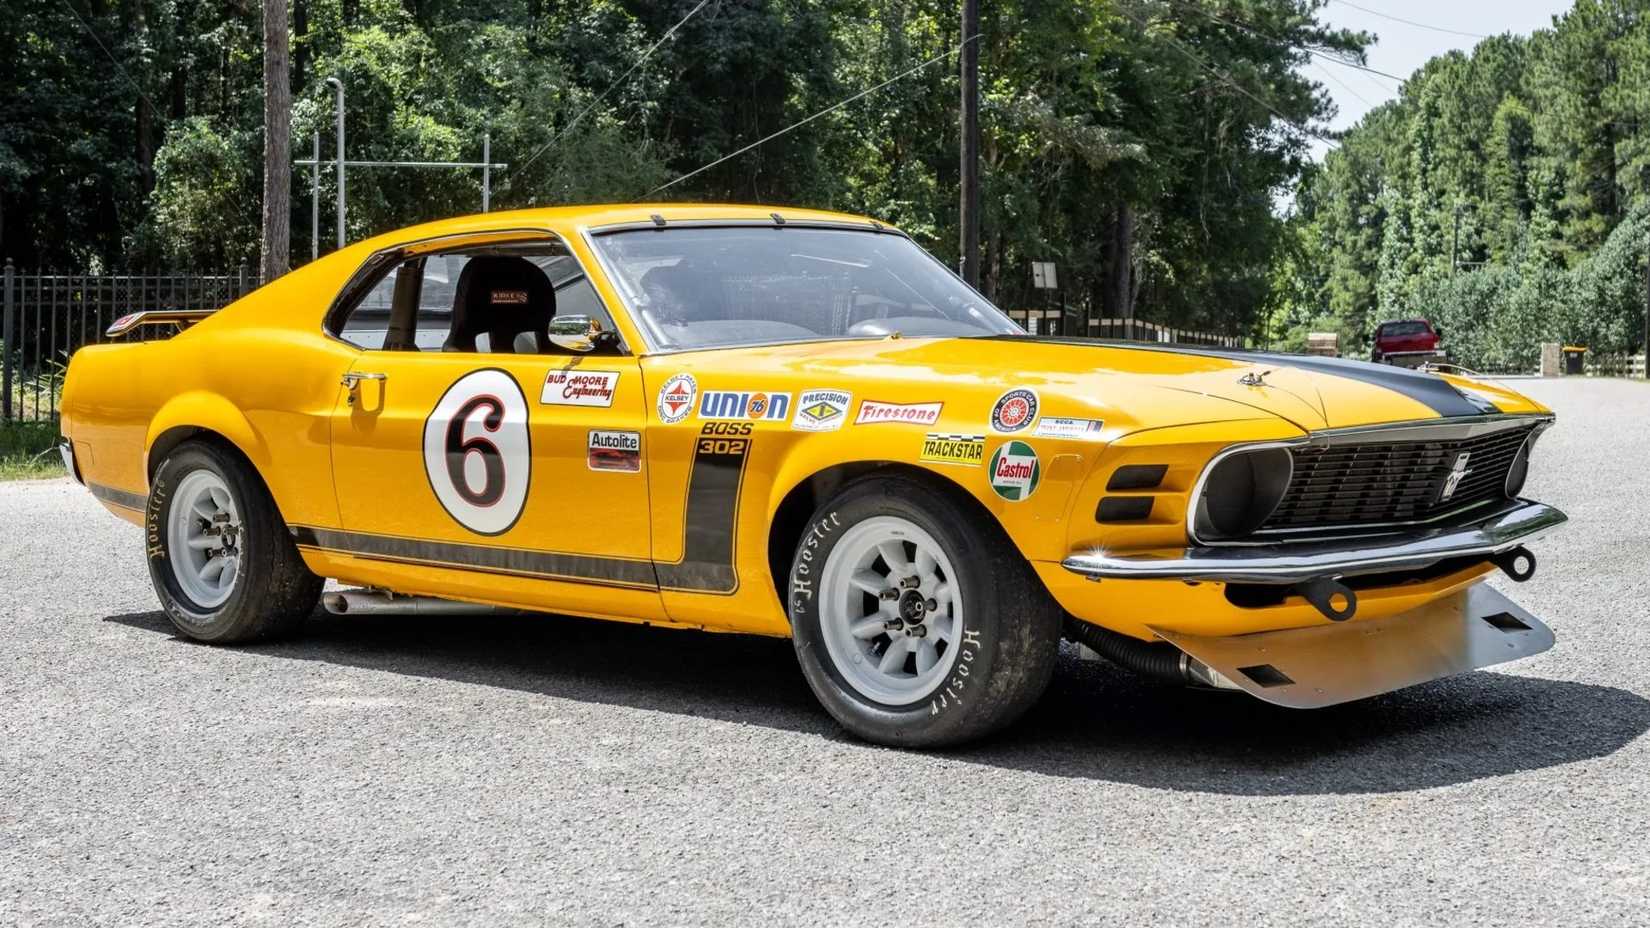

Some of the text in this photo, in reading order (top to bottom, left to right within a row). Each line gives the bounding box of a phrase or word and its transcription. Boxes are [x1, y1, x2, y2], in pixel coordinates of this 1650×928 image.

[547, 374, 609, 387] BUD MOORE
[562, 378, 612, 400] Engineering
[700, 392, 789, 419] UNION
[750, 399, 765, 413] 76
[802, 392, 849, 405] PRECISION
[1000, 391, 1036, 426] SPORTS CAR CLUB
[862, 405, 936, 421] Firestone
[701, 422, 754, 435] BOSS
[445, 393, 505, 508] 6
[592, 433, 637, 449] Autolite
[698, 439, 745, 455] 302
[923, 440, 983, 460] TRACKSTAR
[996, 457, 1034, 479] Castrol
[794, 510, 841, 600] Hoosier
[930, 629, 982, 718] Hoosier
